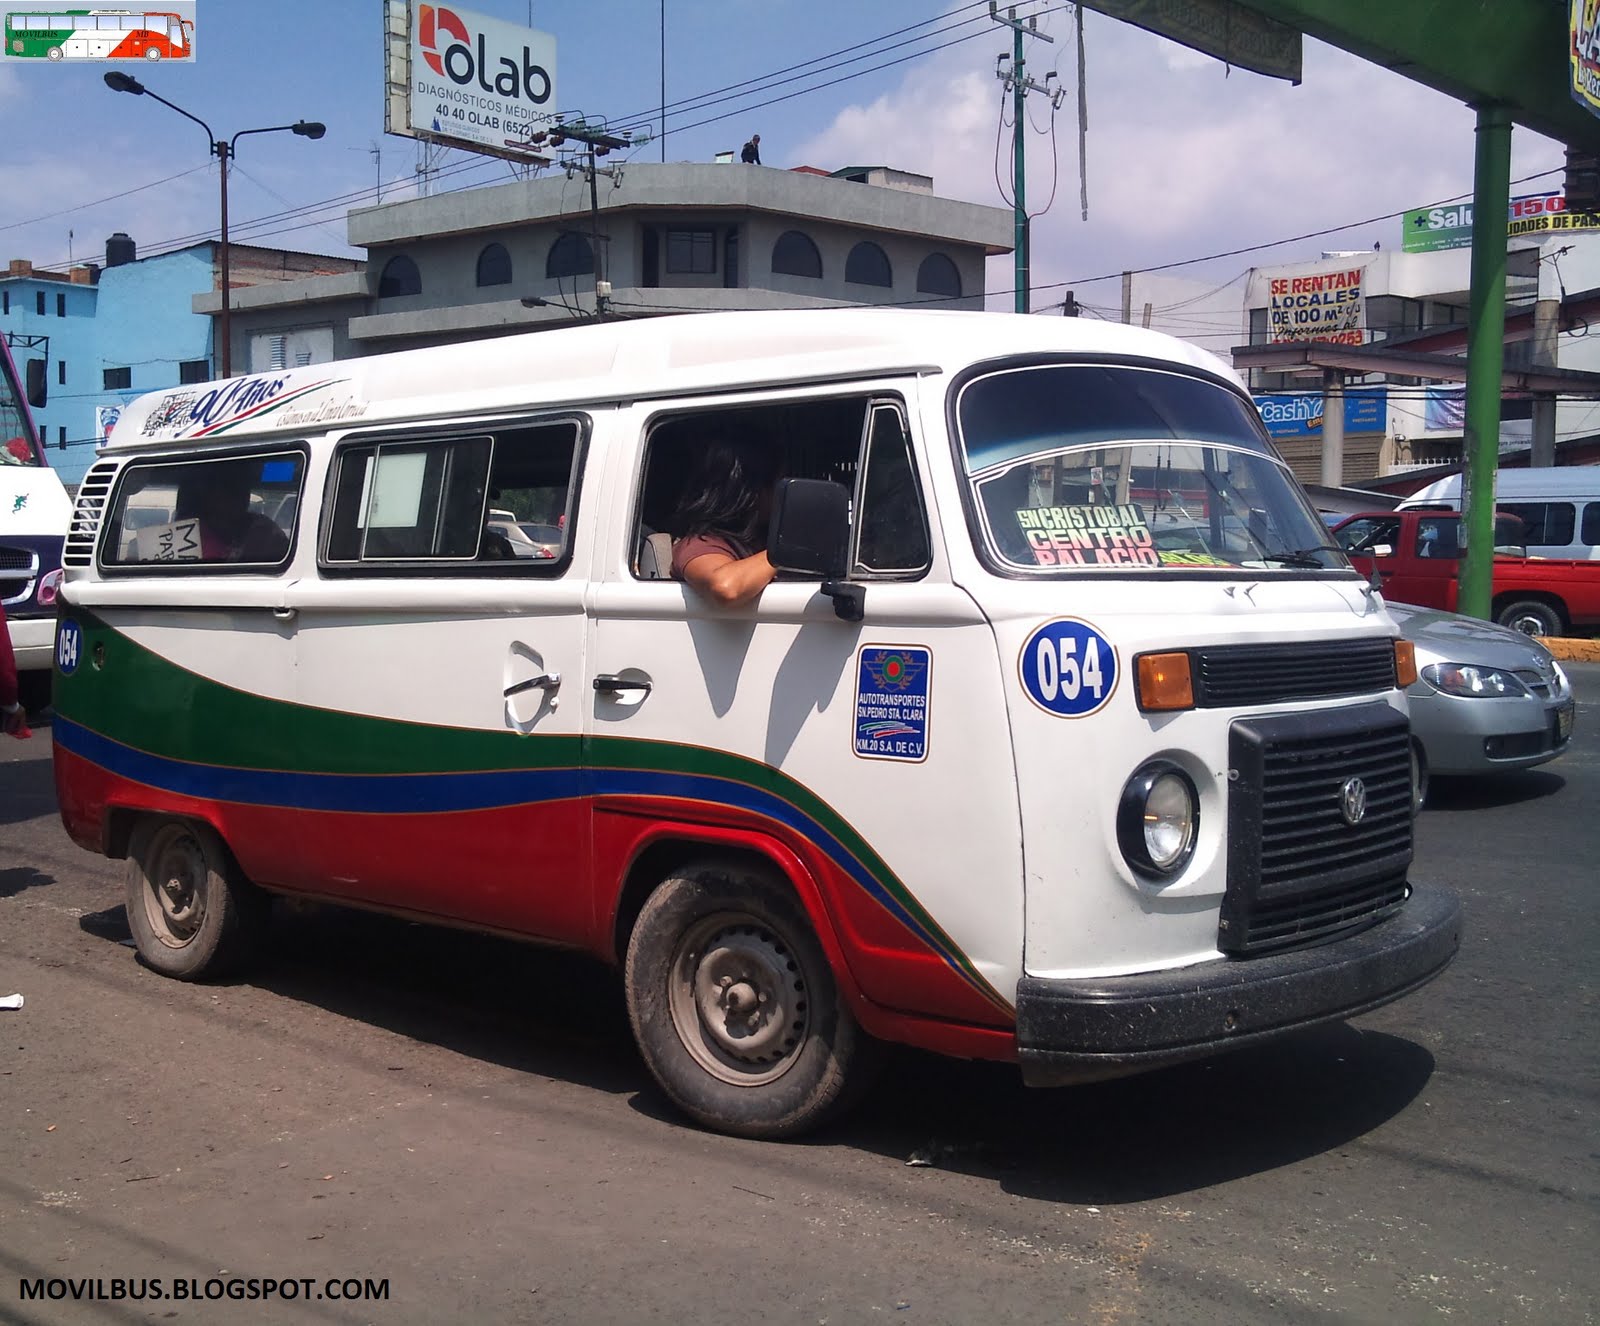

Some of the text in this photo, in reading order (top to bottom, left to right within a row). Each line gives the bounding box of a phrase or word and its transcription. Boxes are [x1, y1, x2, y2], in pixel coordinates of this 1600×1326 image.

[436, 104, 449, 117] 40
[452, 107, 465, 121] 40
[468, 112, 499, 130] OLAB
[1506, 217, 1549, 235] IDADES
[1552, 216, 1569, 229] DE
[1271, 269, 1361, 295] SE RENTAN
[1272, 287, 1360, 309] LOCALES
[1273, 309, 1289, 325] DE
[1294, 308, 1320, 324] 100
[1016, 504, 1146, 529] SN CRISTOBAL
[1026, 526, 1153, 550] CENTRO
[60, 629, 77, 667] 054
[1037, 636, 1103, 701] 054
[858, 693, 925, 707] AUTOTRANSPORTES
[888, 708, 901, 720] STA.
[903, 709, 924, 721] CLARA
[879, 740, 894, 752] S.A.
[896, 741, 907, 753] DE
[908, 743, 923, 754] C.V.
